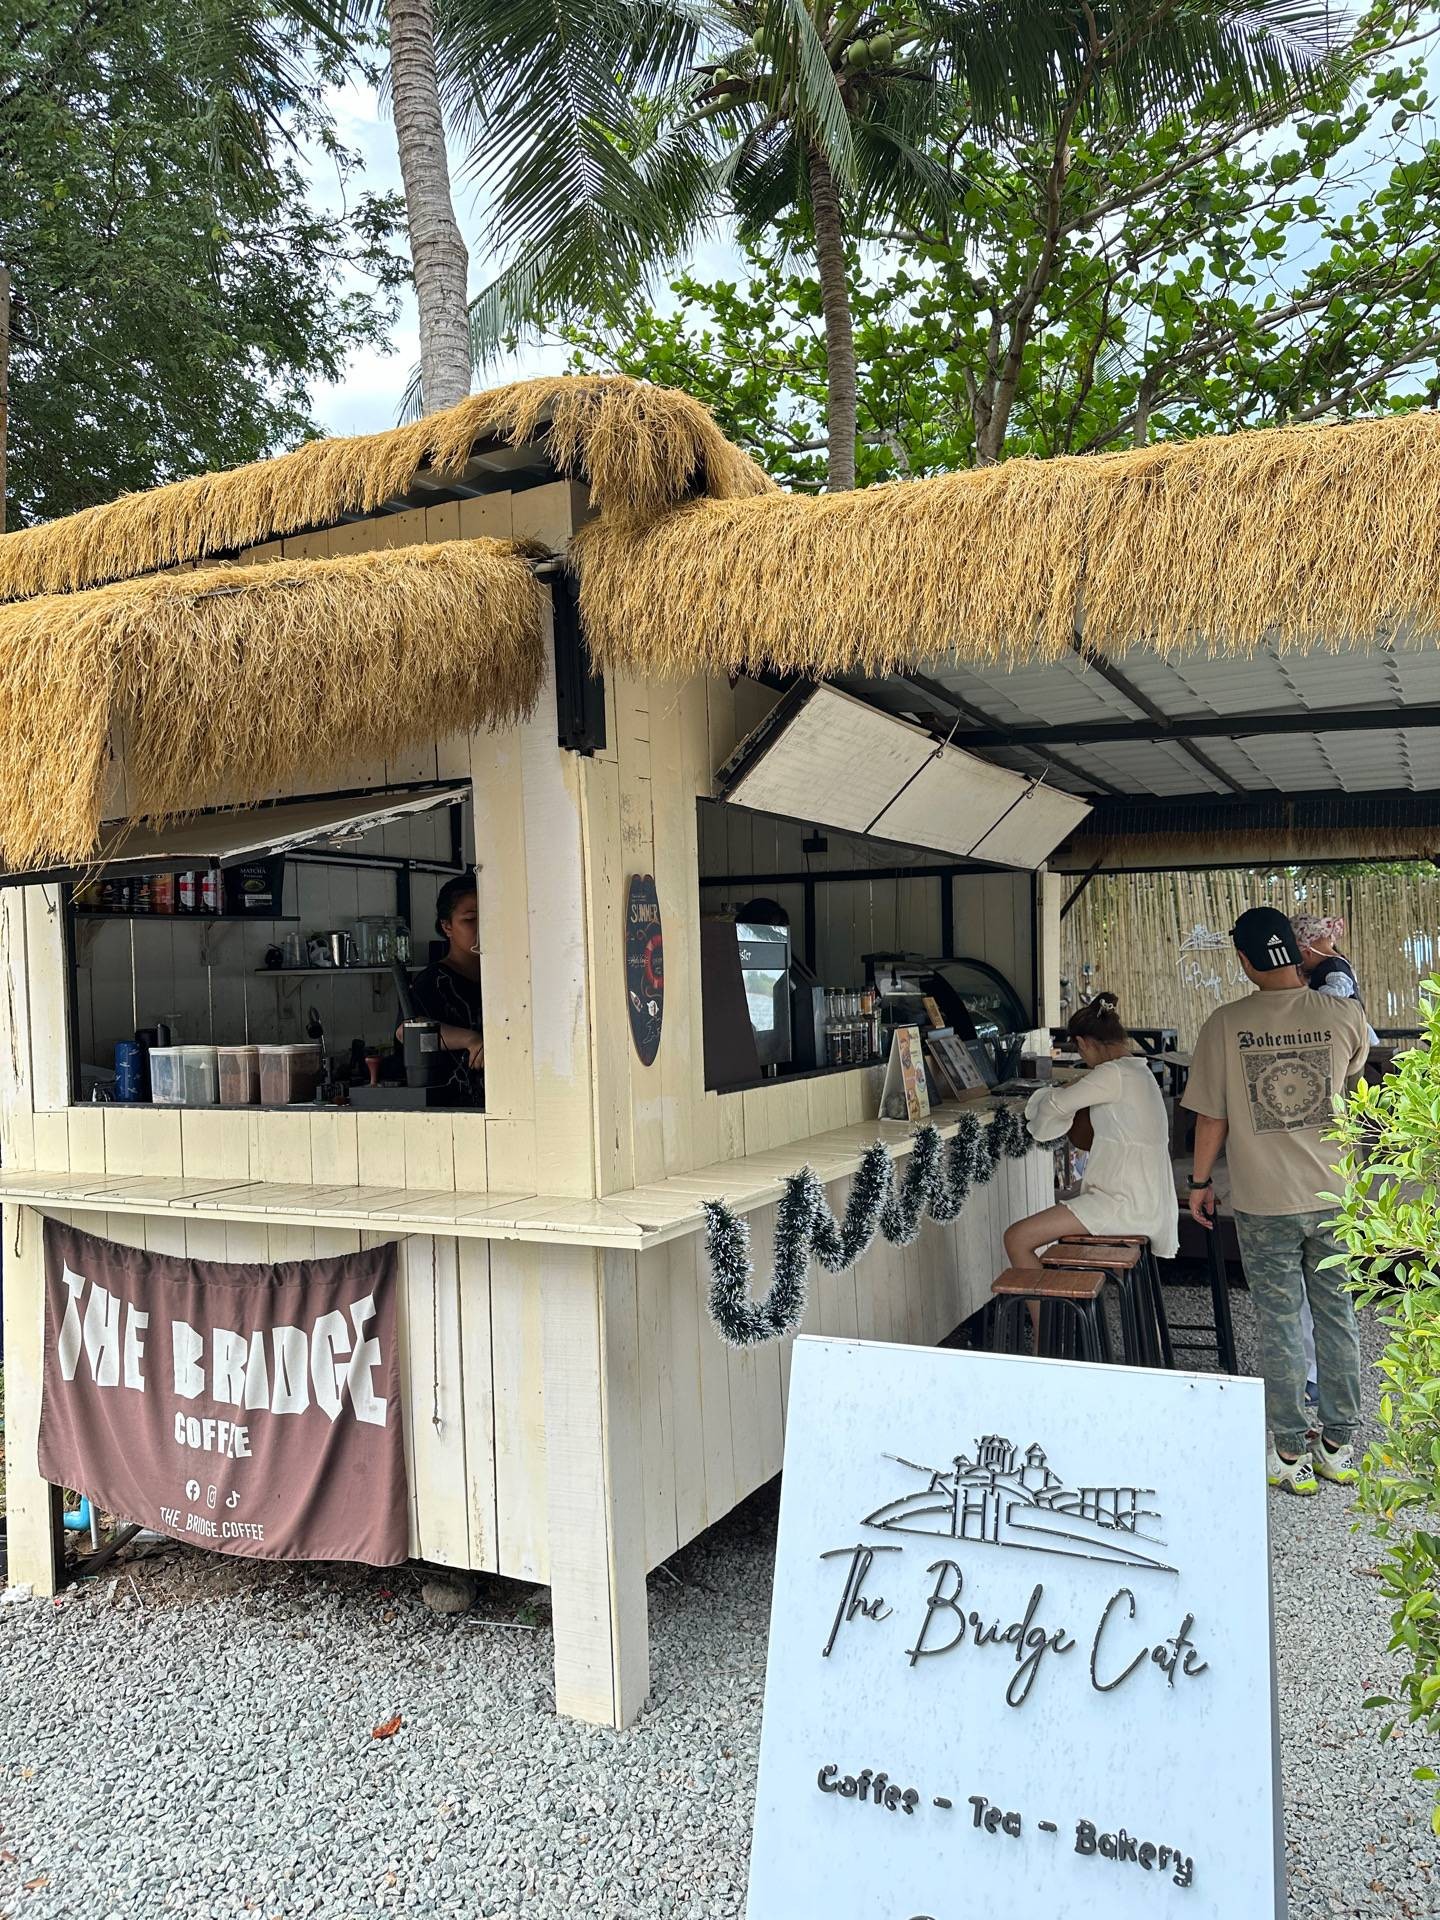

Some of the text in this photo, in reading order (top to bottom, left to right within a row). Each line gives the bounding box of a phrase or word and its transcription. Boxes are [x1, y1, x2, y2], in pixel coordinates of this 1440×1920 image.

[631, 904, 658, 924] SUMMER
[1237, 1029, 1332, 1050] Bohemians
[58, 1258, 388, 1428] THE BRIDGE
[174, 1411, 253, 1459] COFFEE
[159, 1506, 265, 1542] THE_BRIDGE.COFFEE
[819, 1543, 903, 1658] The
[904, 1558, 1076, 1708] Bridge
[817, 1764, 920, 1815] Coffee
[968, 1795, 1022, 1838] Tea
[1073, 1819, 1194, 1888] Bakery
